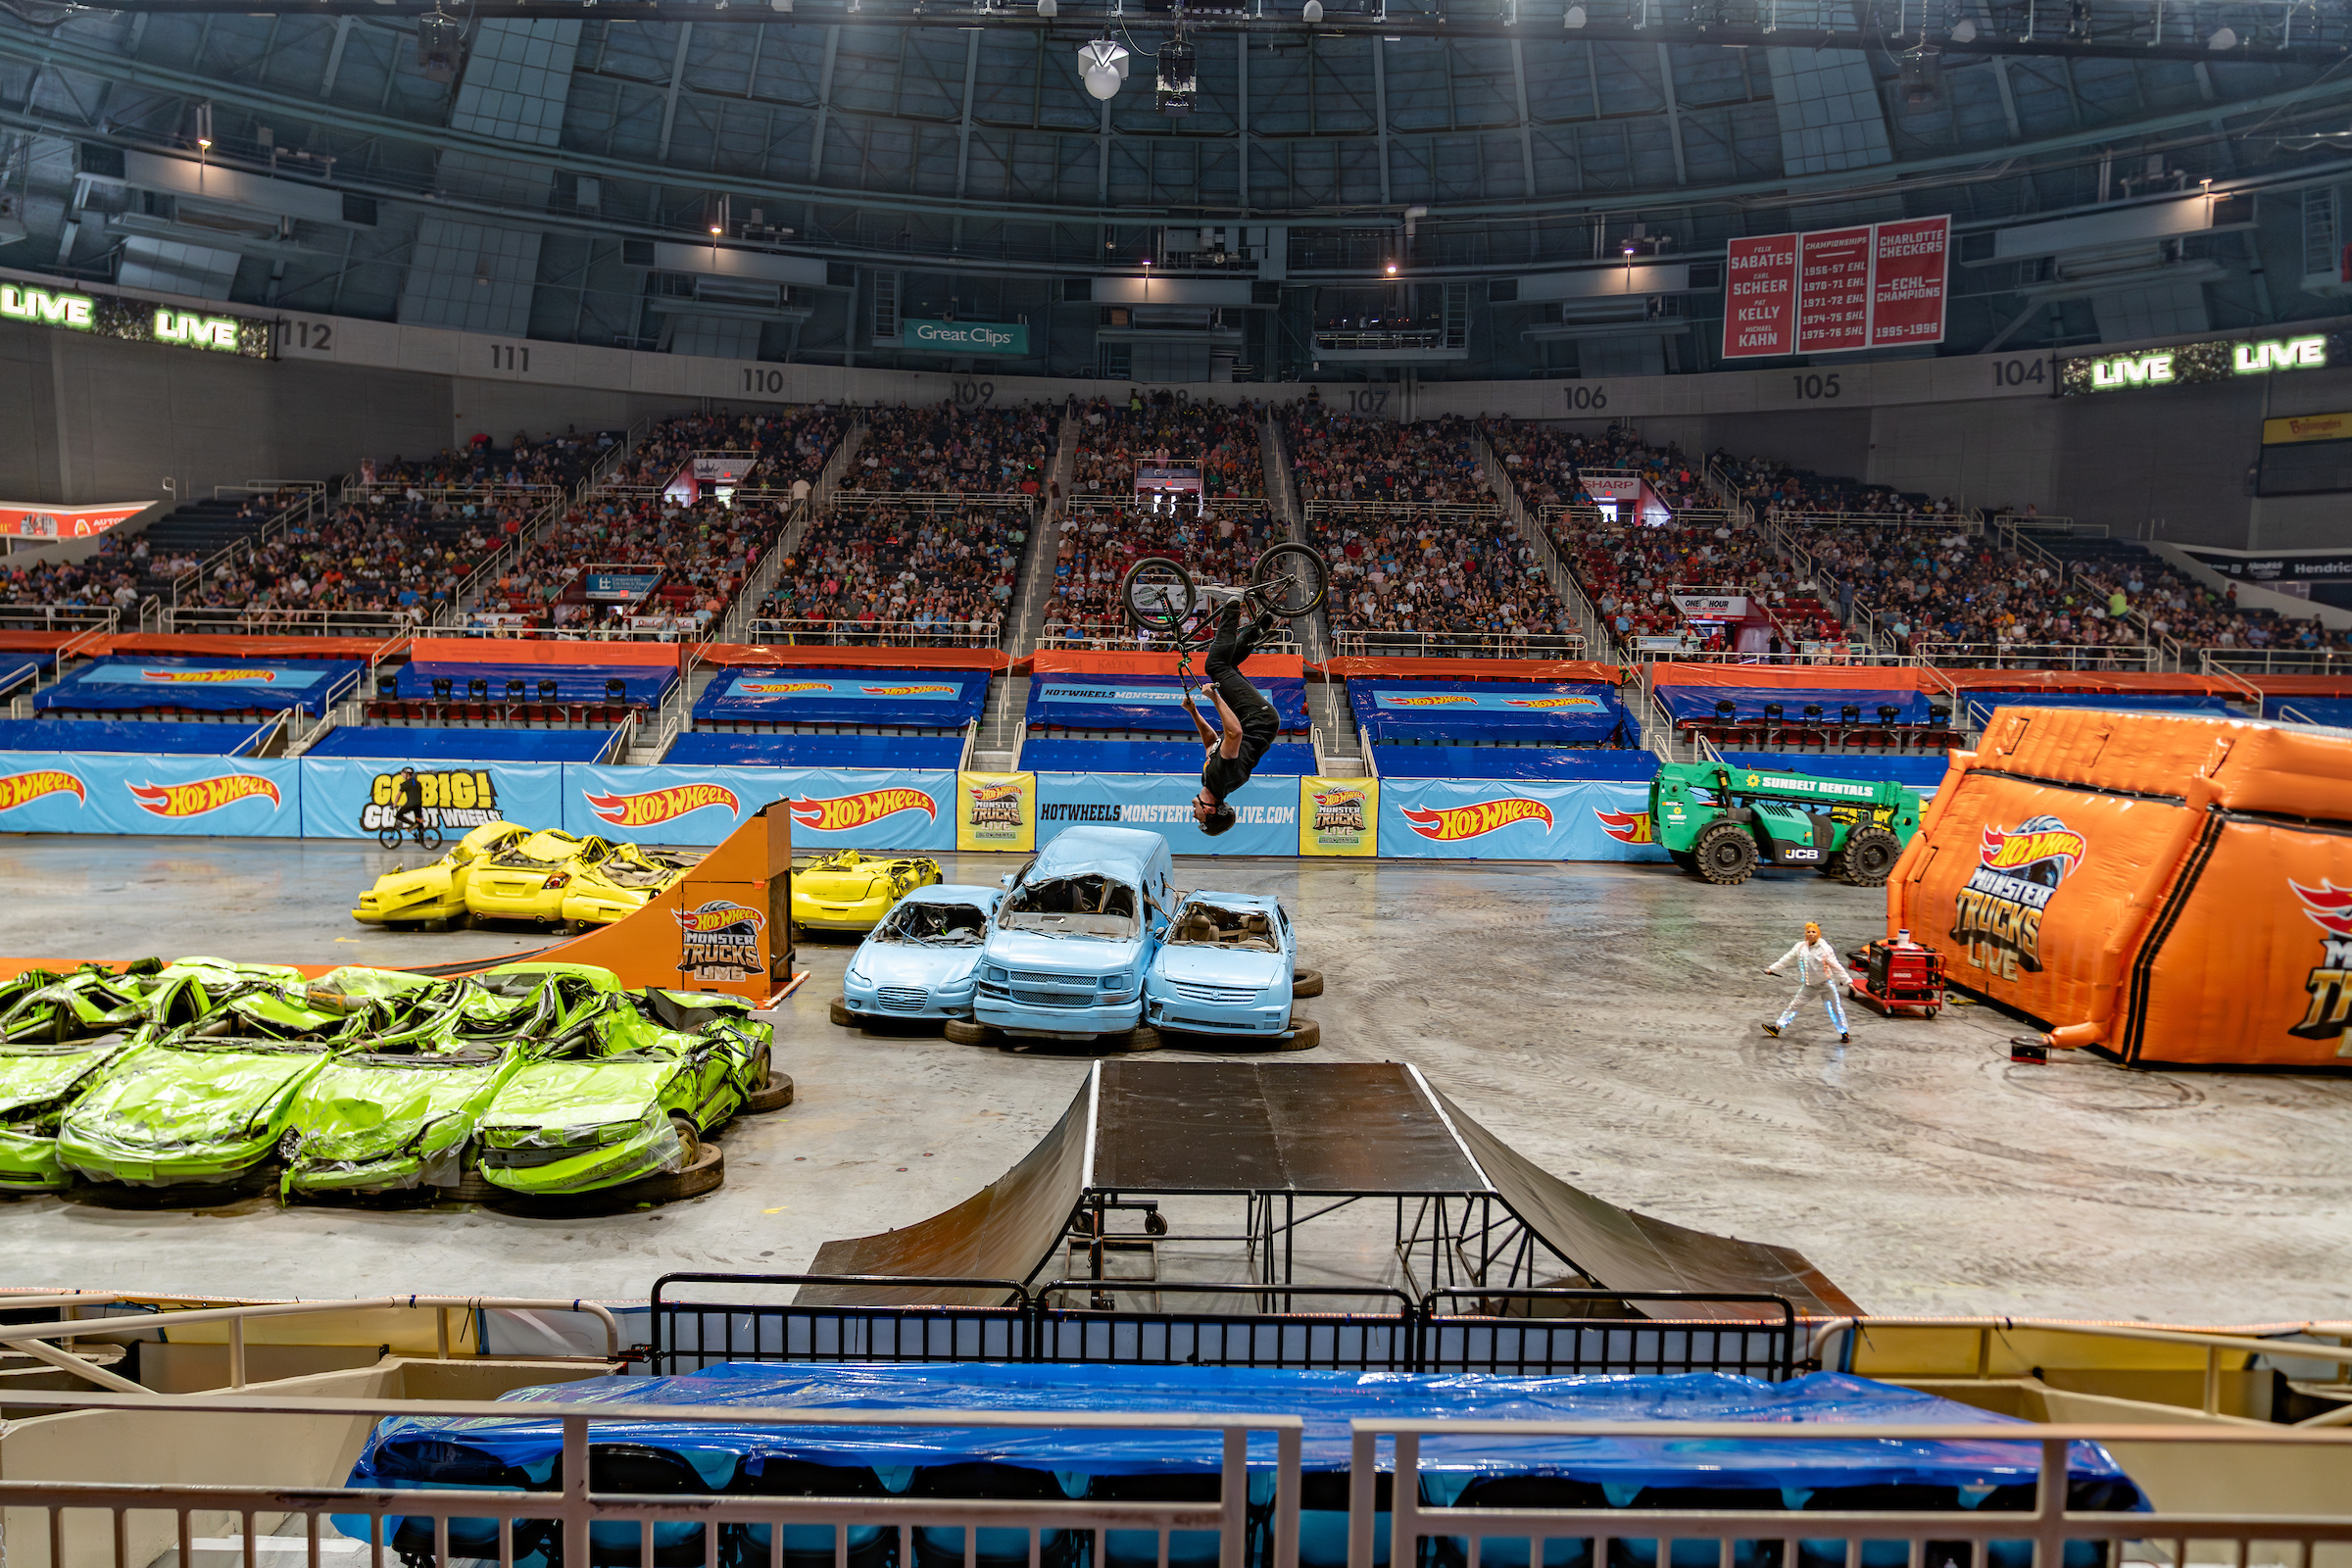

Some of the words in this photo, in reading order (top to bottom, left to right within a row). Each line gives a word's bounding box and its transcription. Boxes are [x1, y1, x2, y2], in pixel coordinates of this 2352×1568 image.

[1805, 236, 1867, 251] CHAMPIONSHIPS
[1880, 229, 1944, 247] CHARLOTTE
[1879, 241, 1943, 259] CHECKERS
[1731, 252, 1793, 270] SABATES
[1847, 262, 1867, 271] EHL
[1733, 279, 1788, 295] SCHEER
[1803, 279, 1843, 292] 1970-71
[1846, 277, 1866, 287] EHL
[1802, 295, 1843, 308] 1971-72
[1845, 293, 1865, 304] EHL
[1877, 287, 1940, 303] CHAMPIONS
[1, 286, 93, 325] LIVE
[1738, 306, 1781, 321] KELLY
[1802, 313, 1842, 325] 1974-75
[1845, 311, 1865, 320] SHL
[157, 312, 237, 347] LIVE
[280, 319, 332, 351] 112
[917, 324, 967, 342] Great
[970, 327, 1011, 347] Clips
[1801, 327, 1841, 340] 1975-76
[1844, 325, 1864, 336] SHL
[1876, 322, 1938, 338] 1995-1996
[1739, 332, 1778, 347] KAHN
[491, 344, 530, 372] 111
[2235, 338, 2327, 371] LIVE
[1992, 359, 2046, 387] 104
[2094, 356, 2175, 386] LIVE
[744, 368, 783, 393] 110
[1793, 373, 1841, 399] 105
[953, 381, 995, 405] 109
[1348, 389, 1391, 413] 107
[1564, 385, 1607, 411] 106
[1582, 480, 1634, 489] SHARP
[2294, 561, 2352, 574] Hendric
[1686, 599, 1699, 608] ONE
[1708, 600, 1730, 609] HOUR
[416, 772, 492, 809] BIG!
[1762, 777, 1817, 792] SUNBELT
[1818, 781, 1874, 797] RENTALS
[972, 808, 1020, 823] TRUCKS
[1315, 812, 1363, 828] TRUCKS
[981, 821, 1010, 830] LIVE
[1325, 826, 1353, 835] LIVE
[1786, 849, 1819, 859] JCB
[1968, 867, 2057, 909] MONSTER
[1952, 888, 2043, 965] TRUCKS
[685, 932, 756, 946] MONSTER
[682, 944, 760, 969] TRUCKS
[1968, 936, 2020, 983] LIVE
[695, 964, 745, 981] LIVE
